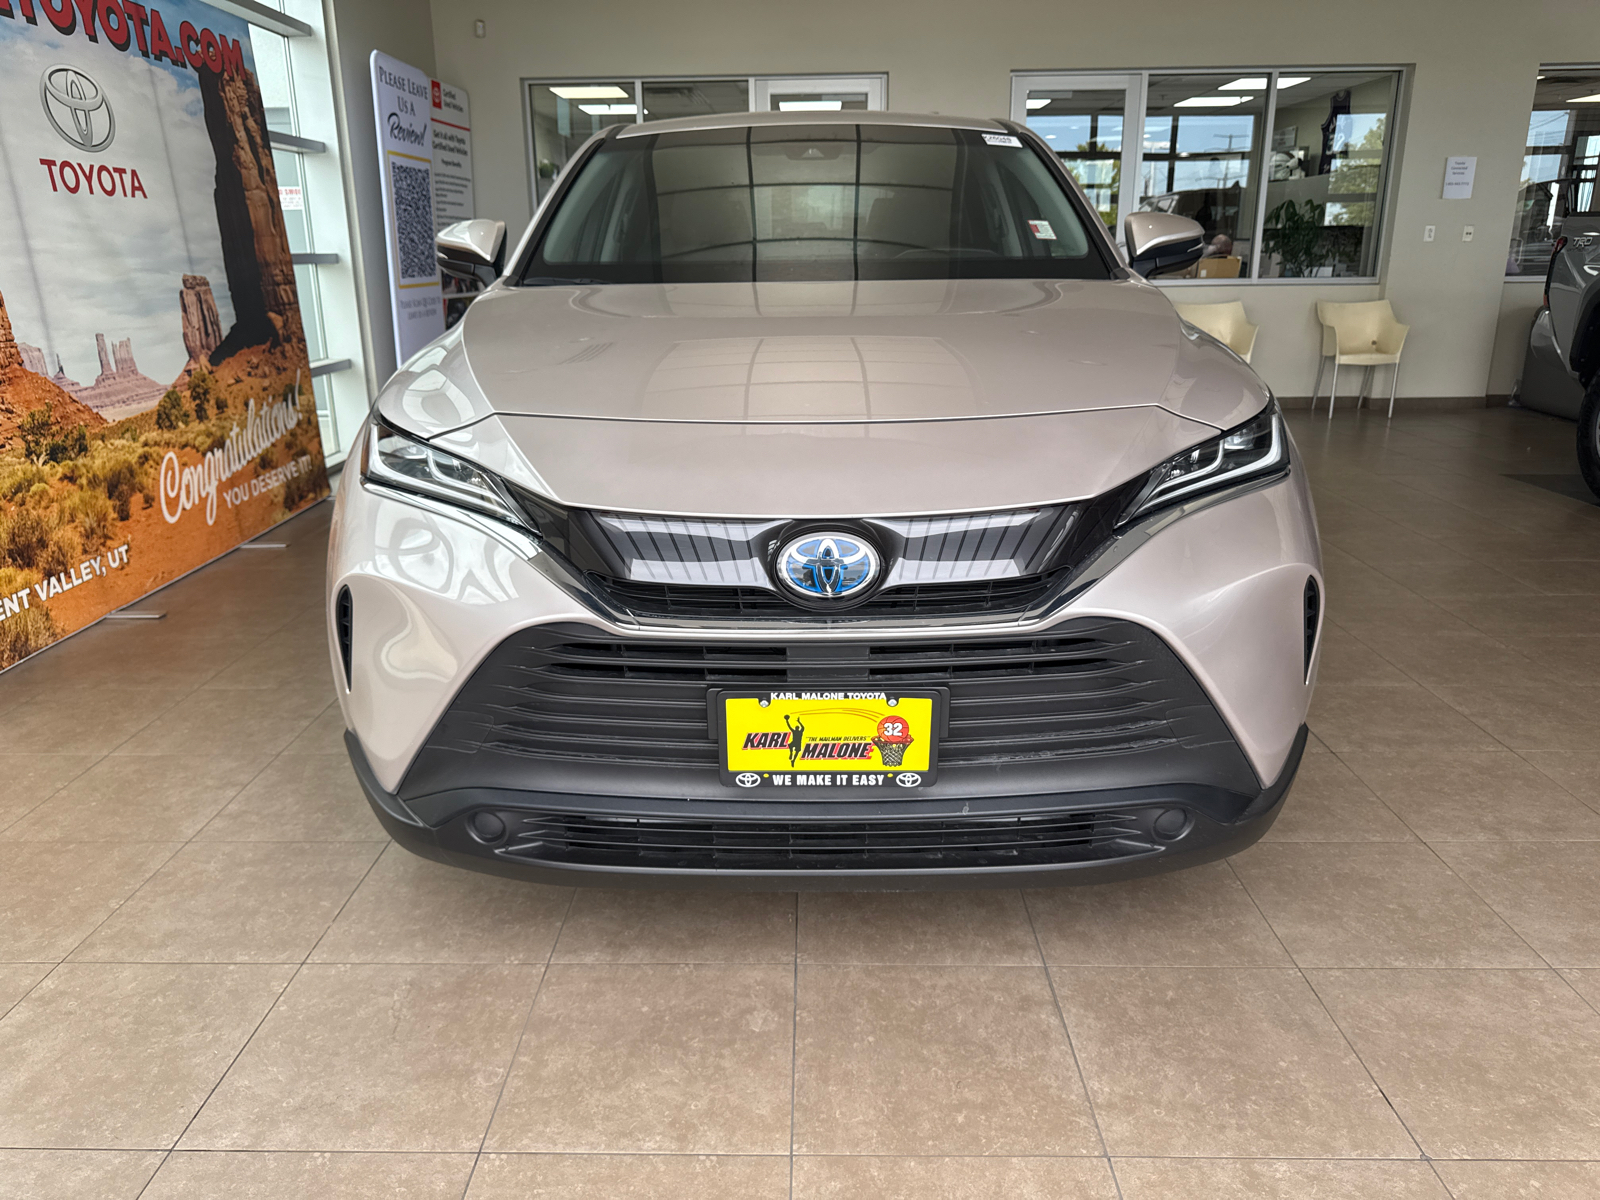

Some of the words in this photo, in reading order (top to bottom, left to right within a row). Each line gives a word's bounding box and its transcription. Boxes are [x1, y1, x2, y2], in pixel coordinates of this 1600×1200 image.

[0, 0, 246, 80] OYOTA.COM
[387, 112, 428, 147] Review!
[39, 158, 148, 199] TOYOTA
[1573, 236, 1593, 248] TRD
[160, 369, 303, 526] Congratulations!
[223, 483, 249, 508] YOU
[251, 461, 299, 496] DESERVE
[297, 454, 313, 474] IT!
[34, 556, 107, 601] VALLEY,
[107, 544, 129, 568] UT
[770, 692, 798, 700] KARL
[801, 692, 844, 700] MALONE
[847, 692, 887, 700] TOYOTA
[742, 732, 791, 750] KARL
[883, 722, 903, 736] 32
[800, 743, 875, 760] MALONE
[772, 774, 792, 786] WE
[796, 774, 832, 786] MAKE
[836, 774, 848, 786] IT
[852, 774, 885, 786] EASY
